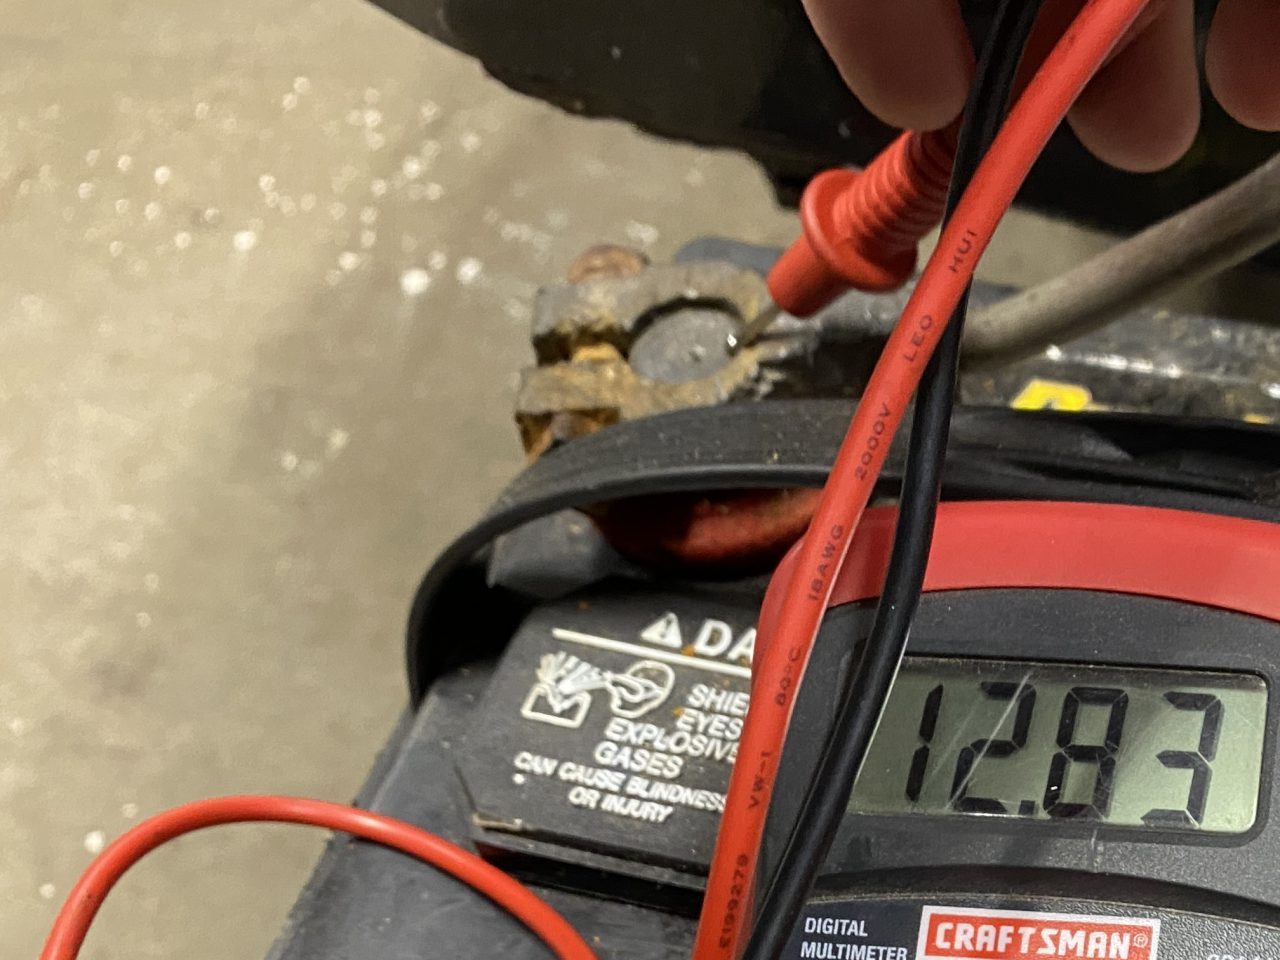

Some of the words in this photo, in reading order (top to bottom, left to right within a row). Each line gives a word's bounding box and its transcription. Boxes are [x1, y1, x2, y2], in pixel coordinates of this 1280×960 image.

[855, 402, 890, 481] 2000V
[904, 315, 933, 362] LEO
[949, 230, 977, 272] HUI
[688, 684, 750, 716] SHIE
[675, 708, 744, 741] EYES
[514, 751, 558, 776] CAN
[559, 762, 625, 791] CAUSE
[594, 741, 683, 779] GASES
[906, 681, 1225, 829] 12.83
[568, 786, 600, 808] OR
[602, 792, 674, 823] INJURY
[804, 917, 868, 937] DIGITAL
